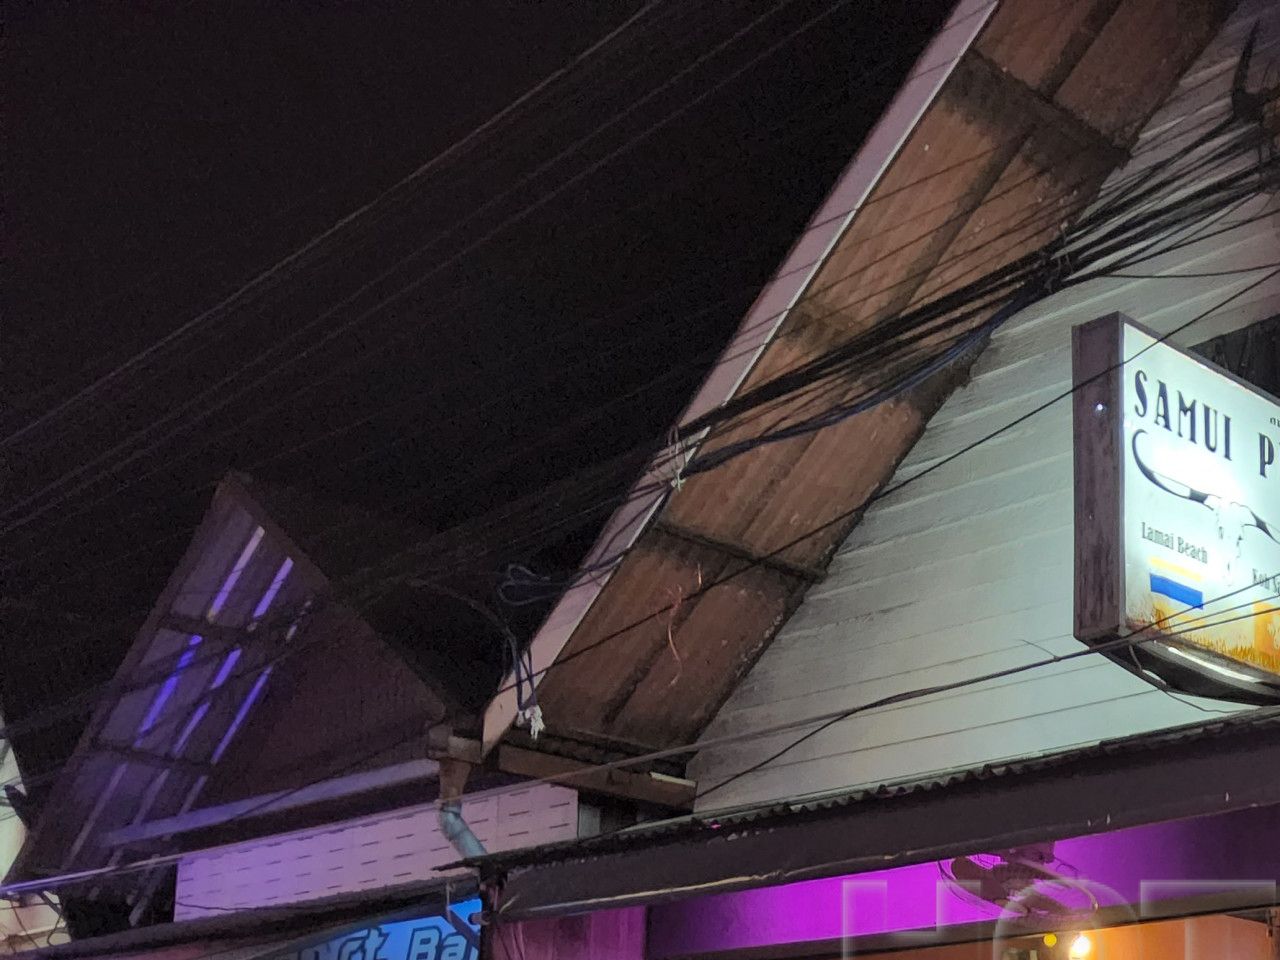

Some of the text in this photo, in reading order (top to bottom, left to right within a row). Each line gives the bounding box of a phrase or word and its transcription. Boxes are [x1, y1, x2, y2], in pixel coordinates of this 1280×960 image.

[1133, 369, 1233, 462] SAMUI
[1140, 521, 1208, 565] Lamai Beach
